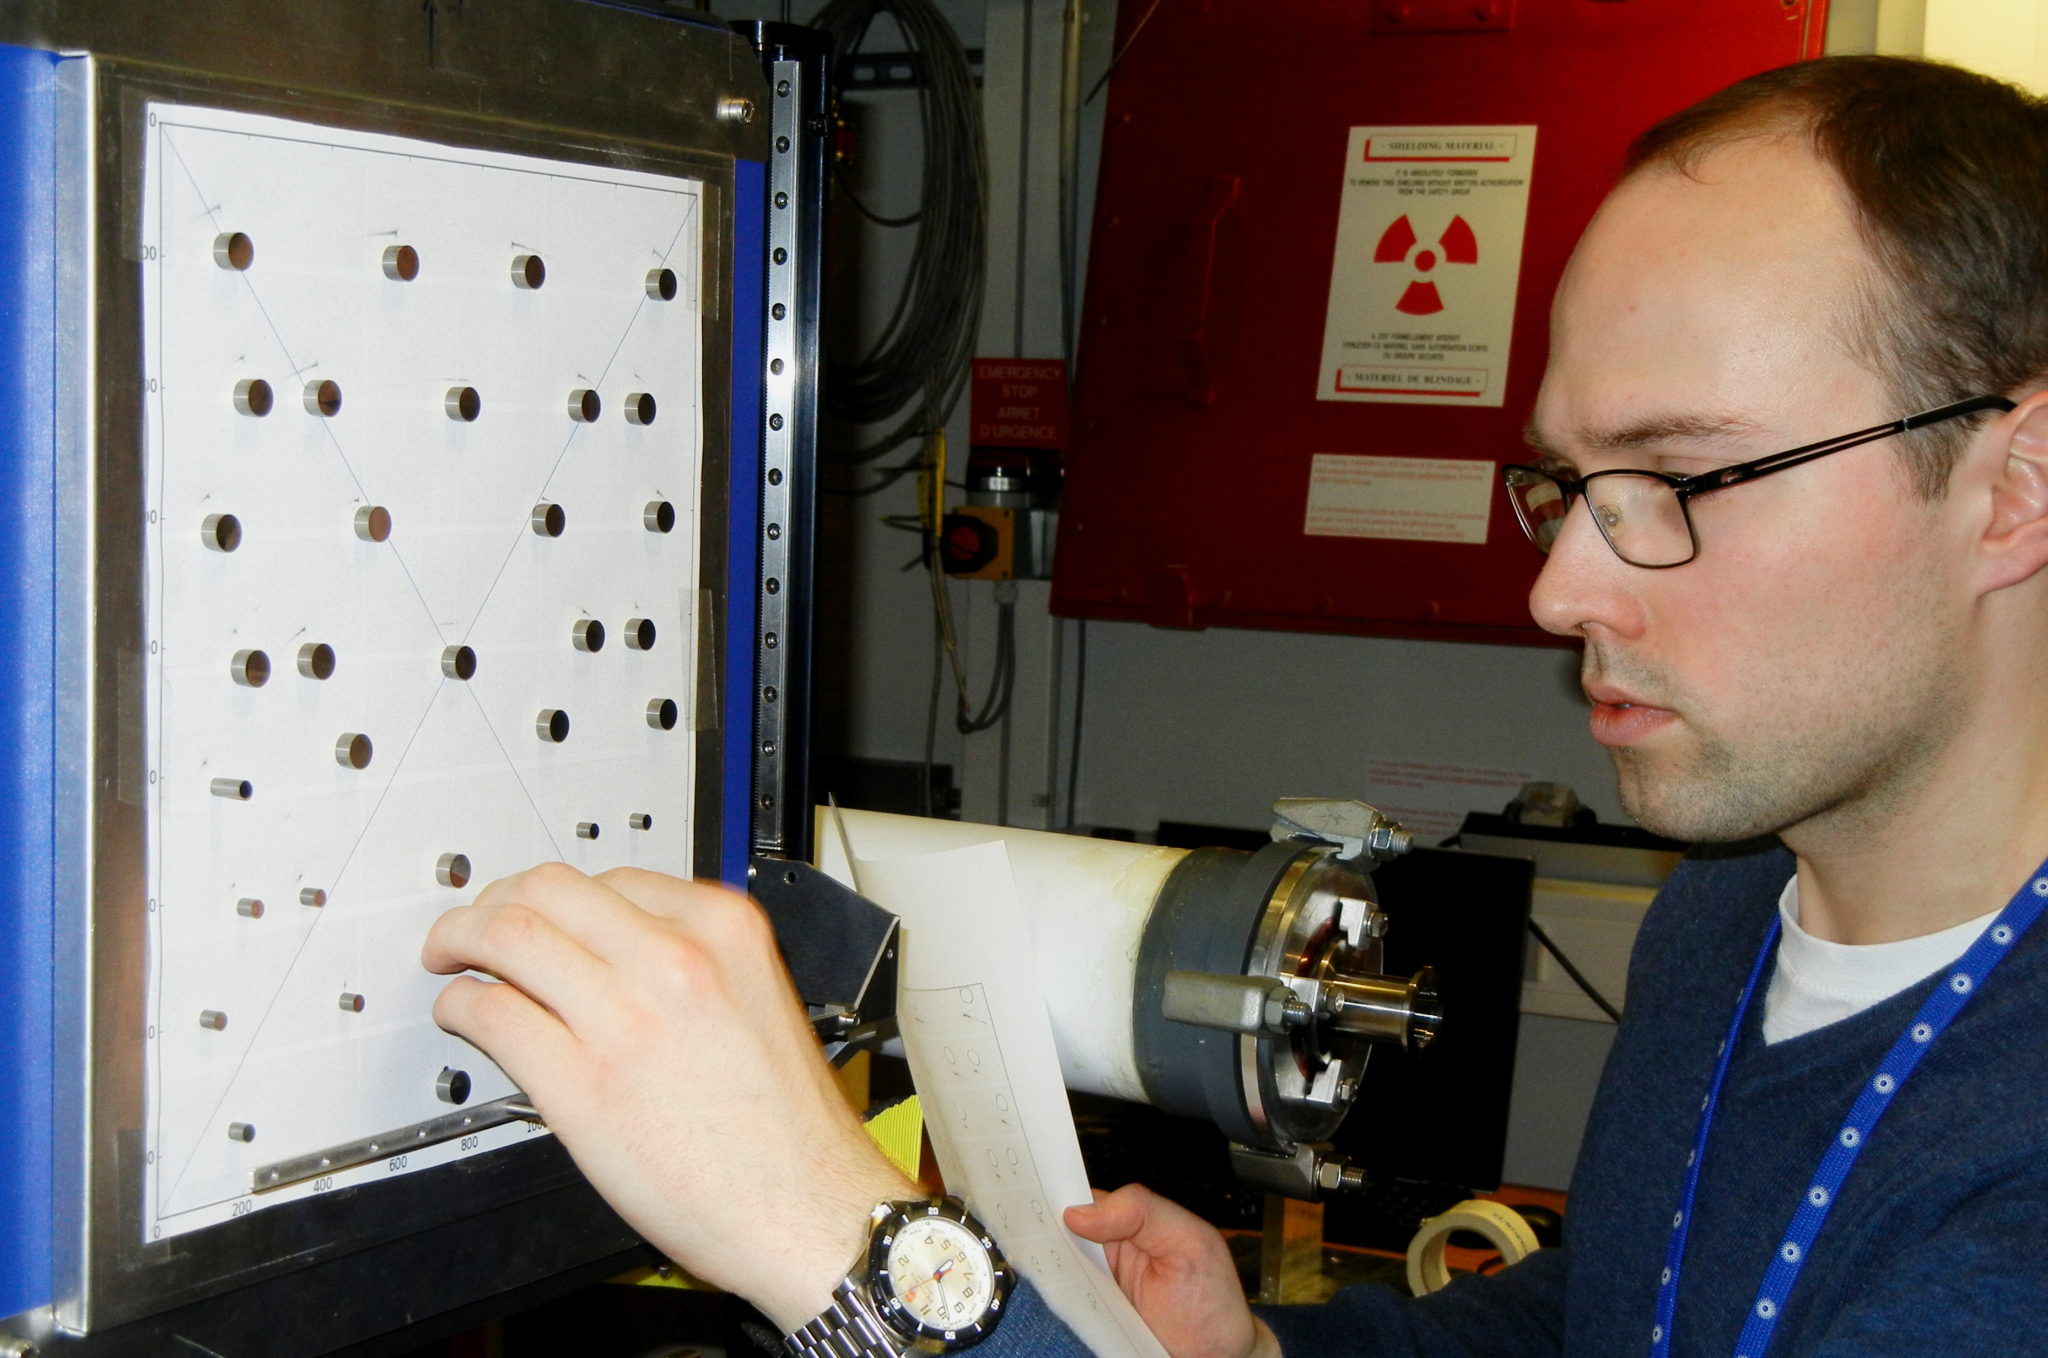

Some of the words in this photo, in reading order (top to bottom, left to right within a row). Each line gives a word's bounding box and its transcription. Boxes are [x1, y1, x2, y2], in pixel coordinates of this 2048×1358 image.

[149, 112, 157, 127] 0
[1388, 141, 1442, 151] SHIELDING
[1445, 141, 1495, 151] MATERIAL
[979, 366, 1062, 381] EMERGENCY
[1354, 373, 1402, 383] MATERIEL
[1406, 374, 1419, 383] DE
[1423, 375, 1473, 386] BLINDAGE
[1002, 384, 1039, 399] STOP
[997, 406, 1041, 420] ARRET
[979, 424, 1057, 440] D'URGENCE
[461, 1135, 479, 1151] 800
[389, 1155, 408, 1172] 600
[313, 1176, 333, 1193] 400
[231, 1199, 253, 1217] 200
[928, 1206, 939, 1215] 20
[153, 1225, 161, 1239] 0
[981, 1236, 993, 1248] 30
[898, 1255, 909, 1267] 2
[962, 1287, 974, 1299] 8
[890, 1297, 901, 1310] 60
[944, 1331, 956, 1340] 50
